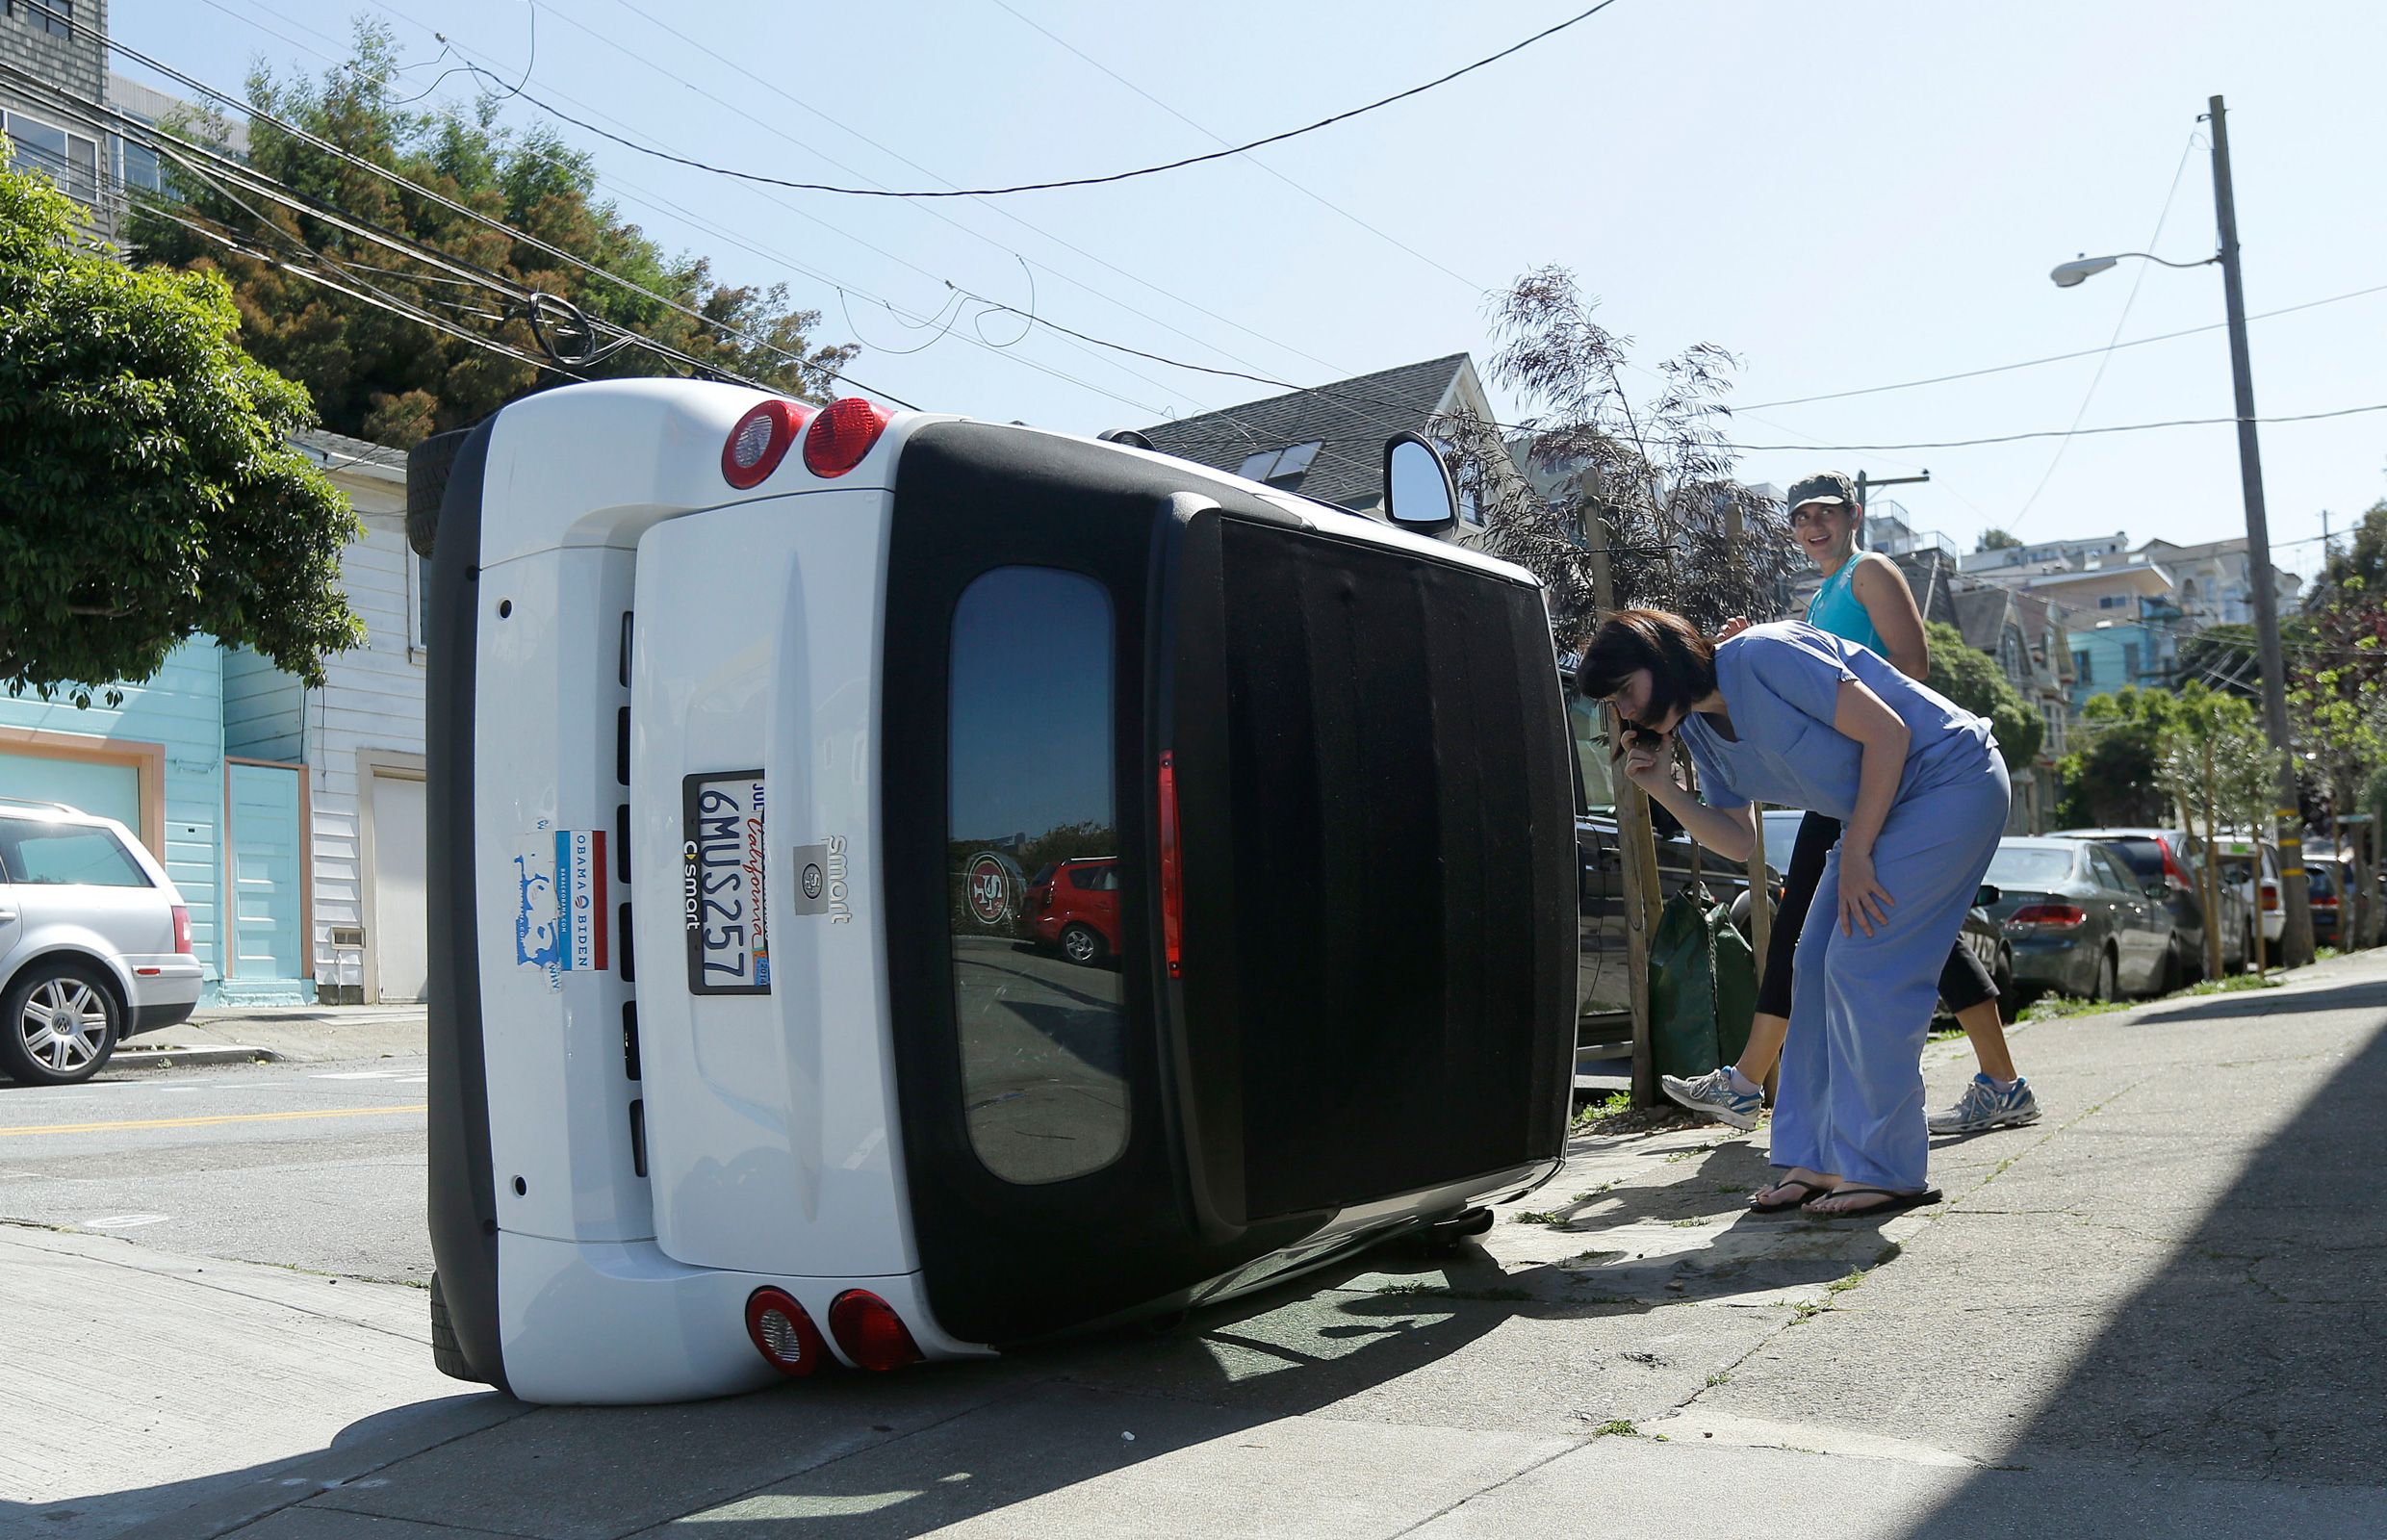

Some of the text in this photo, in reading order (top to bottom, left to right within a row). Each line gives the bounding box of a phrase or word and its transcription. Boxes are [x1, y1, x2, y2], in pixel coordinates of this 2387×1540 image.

[752, 783, 764, 810] JUL
[577, 834, 588, 967] OBAMA BIDEN
[684, 863, 700, 931] smart
[700, 790, 744, 977] 6MUS257
[742, 817, 763, 949] California
[829, 835, 853, 924] smart
[974, 874, 1002, 911] SF
